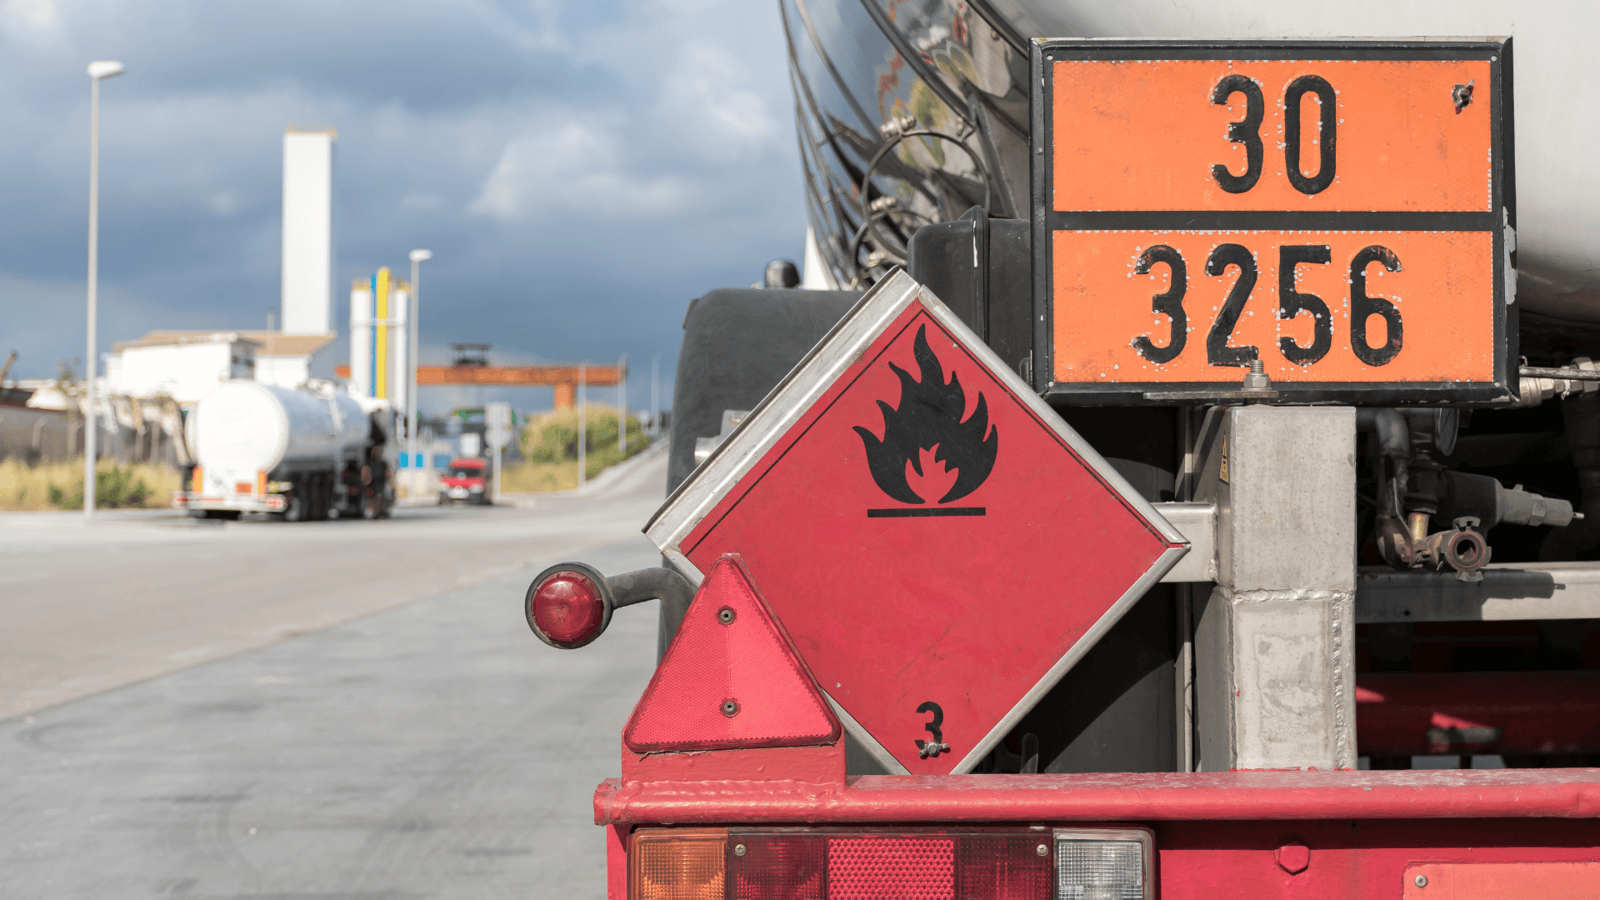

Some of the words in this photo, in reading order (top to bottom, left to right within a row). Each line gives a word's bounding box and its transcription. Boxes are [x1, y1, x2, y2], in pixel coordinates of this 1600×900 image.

[1211, 74, 1337, 194] 30
[1132, 243, 1404, 367] 3256
[914, 701, 944, 753] 3
